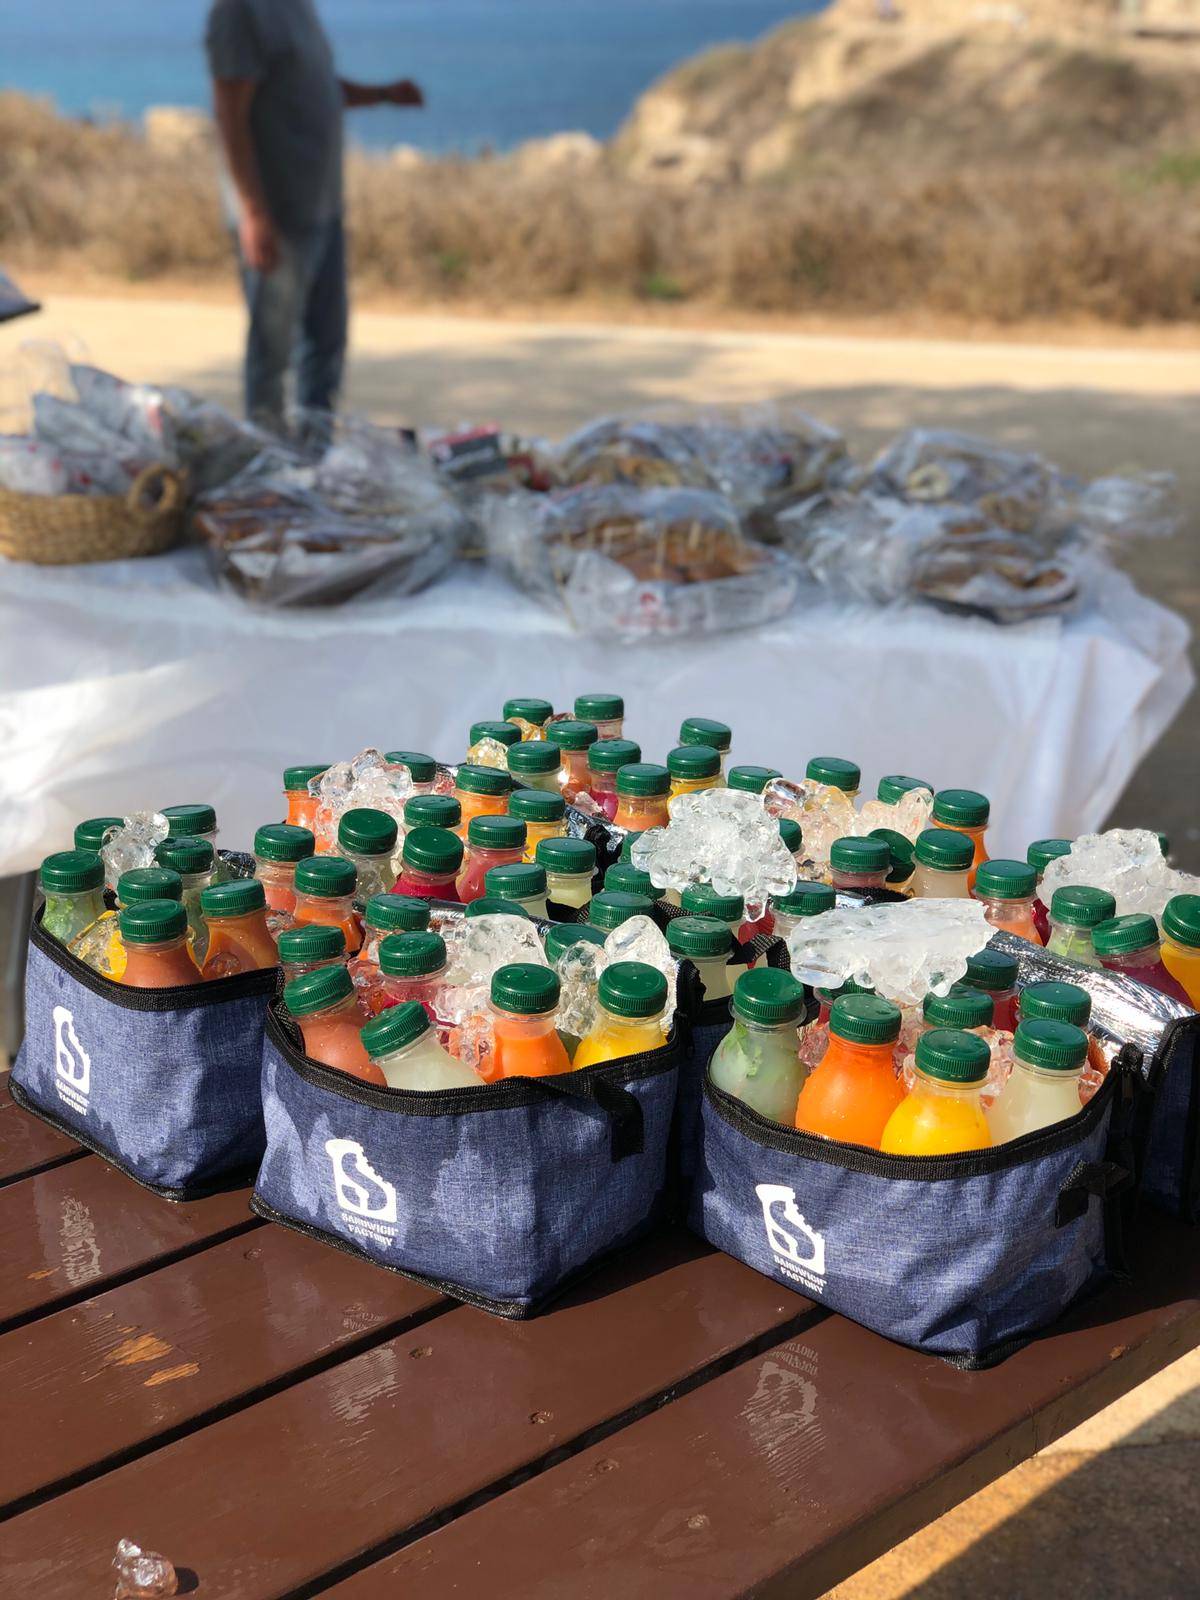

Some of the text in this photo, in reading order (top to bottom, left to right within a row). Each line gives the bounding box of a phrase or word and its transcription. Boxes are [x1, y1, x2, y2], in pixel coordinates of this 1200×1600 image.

[342, 1213, 395, 1236] SANDWICH
[348, 1224, 393, 1246] FACTORY
[773, 1255, 825, 1287] SANDWICH
[780, 1266, 823, 1295] FACTORY
